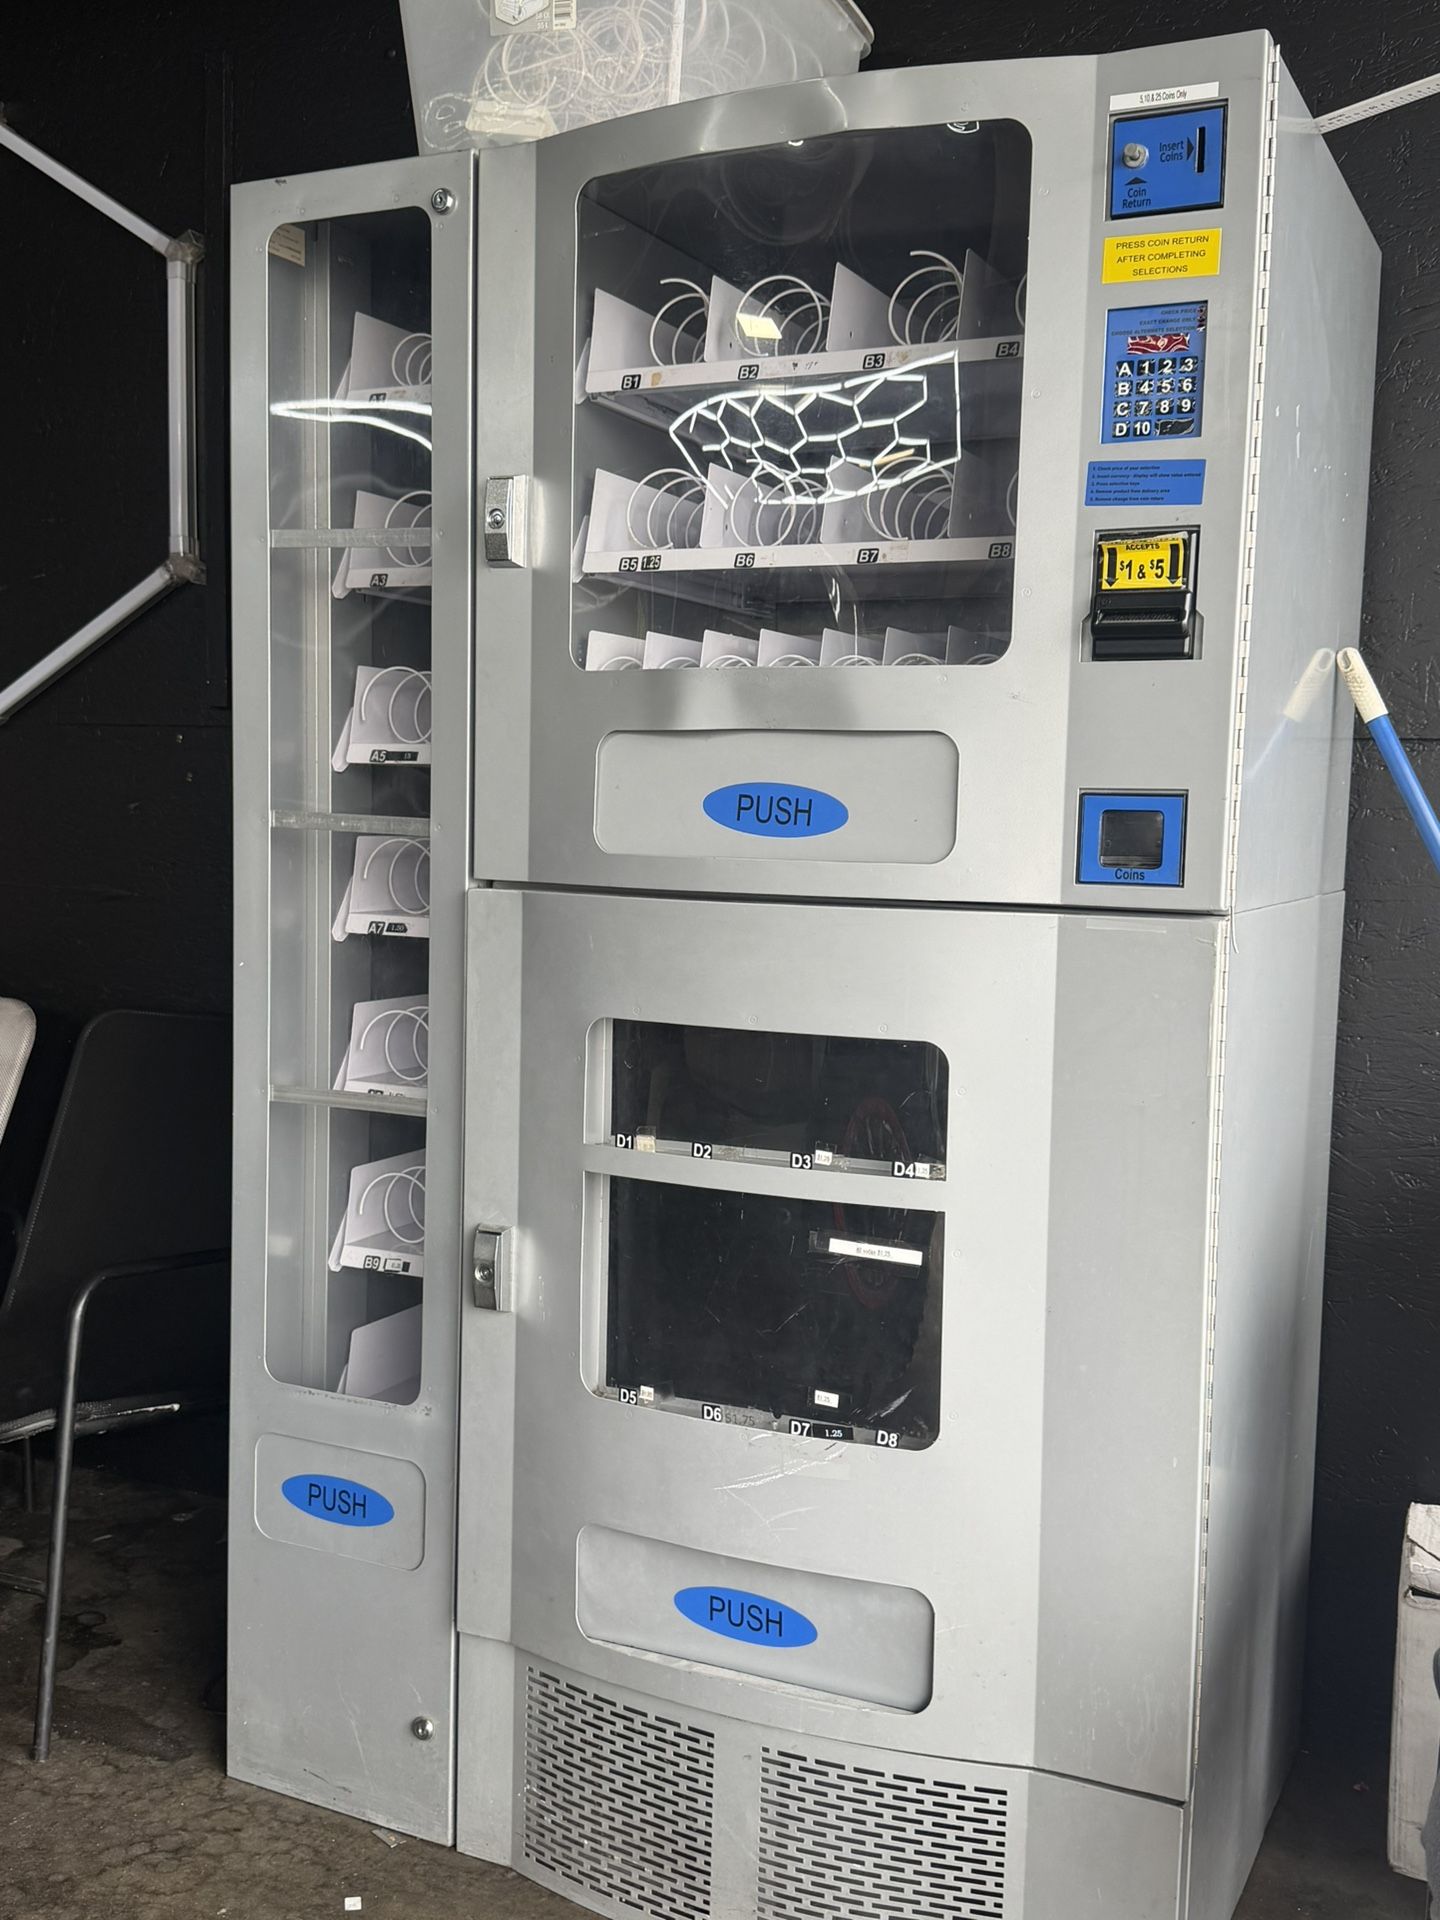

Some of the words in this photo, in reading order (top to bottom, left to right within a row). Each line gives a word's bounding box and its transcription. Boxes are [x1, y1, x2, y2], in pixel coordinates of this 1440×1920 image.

[1162, 92, 1175, 100] Coins
[1176, 90, 1188, 99] Only
[1159, 142, 1184, 152] Insert
[1160, 152, 1184, 162] Coins
[1127, 187, 1147, 198] Coin
[1122, 198, 1151, 209] Return
[1116, 240, 1145, 249] PRESS
[1147, 238, 1170, 248] COIN
[1172, 235, 1209, 245] RETURN
[1116, 254, 1146, 264] AFTER
[1147, 250, 1206, 262] COMPLETING
[1132, 265, 1188, 276] SELECTIONS
[997, 343, 1019, 356] B4
[864, 356, 883, 368] B3
[1118, 362, 1131, 376] A
[1141, 361, 1150, 374] 1
[1163, 360, 1173, 373] 2
[1184, 358, 1193, 371] 3
[739, 366, 757, 378] B2
[622, 377, 640, 389] B1
[1118, 383, 1130, 395] B
[1139, 381, 1150, 394] 4
[1161, 380, 1171, 392] 5
[1183, 378, 1192, 391] 6
[1116, 402, 1128, 416] C
[1139, 401, 1148, 414] 7
[1160, 400, 1169, 412] 8
[1181, 399, 1191, 411] 9
[1115, 423, 1127, 436] D
[1134, 422, 1150, 435] 10
[990, 544, 1011, 557] B8
[1125, 543, 1160, 551] ACCEPTS
[620, 559, 637, 571] B5
[641, 556, 661, 569] 1.25
[735, 555, 754, 567] B6
[858, 550, 878, 563] B7
[1119, 559, 1133, 580] $1
[1137, 564, 1146, 579] &
[1149, 558, 1165, 579] $5
[371, 574, 386, 586] A3
[371, 750, 387, 762] A5
[736, 793, 813, 827] PUSH
[1114, 868, 1146, 881] Coins
[368, 923, 384, 934] A7
[616, 1134, 633, 1149] D1
[693, 1143, 712, 1159] D2
[791, 1153, 812, 1170] D3
[893, 1161, 915, 1178] D4
[365, 1256, 380, 1270] B9
[620, 1388, 637, 1405] D5
[703, 1405, 722, 1421] D6
[790, 1421, 811, 1437] D7
[824, 1428, 843, 1438] 1.25
[876, 1430, 898, 1447] D8
[308, 1482, 367, 1519] PUSH
[708, 1595, 783, 1638] PUSH
